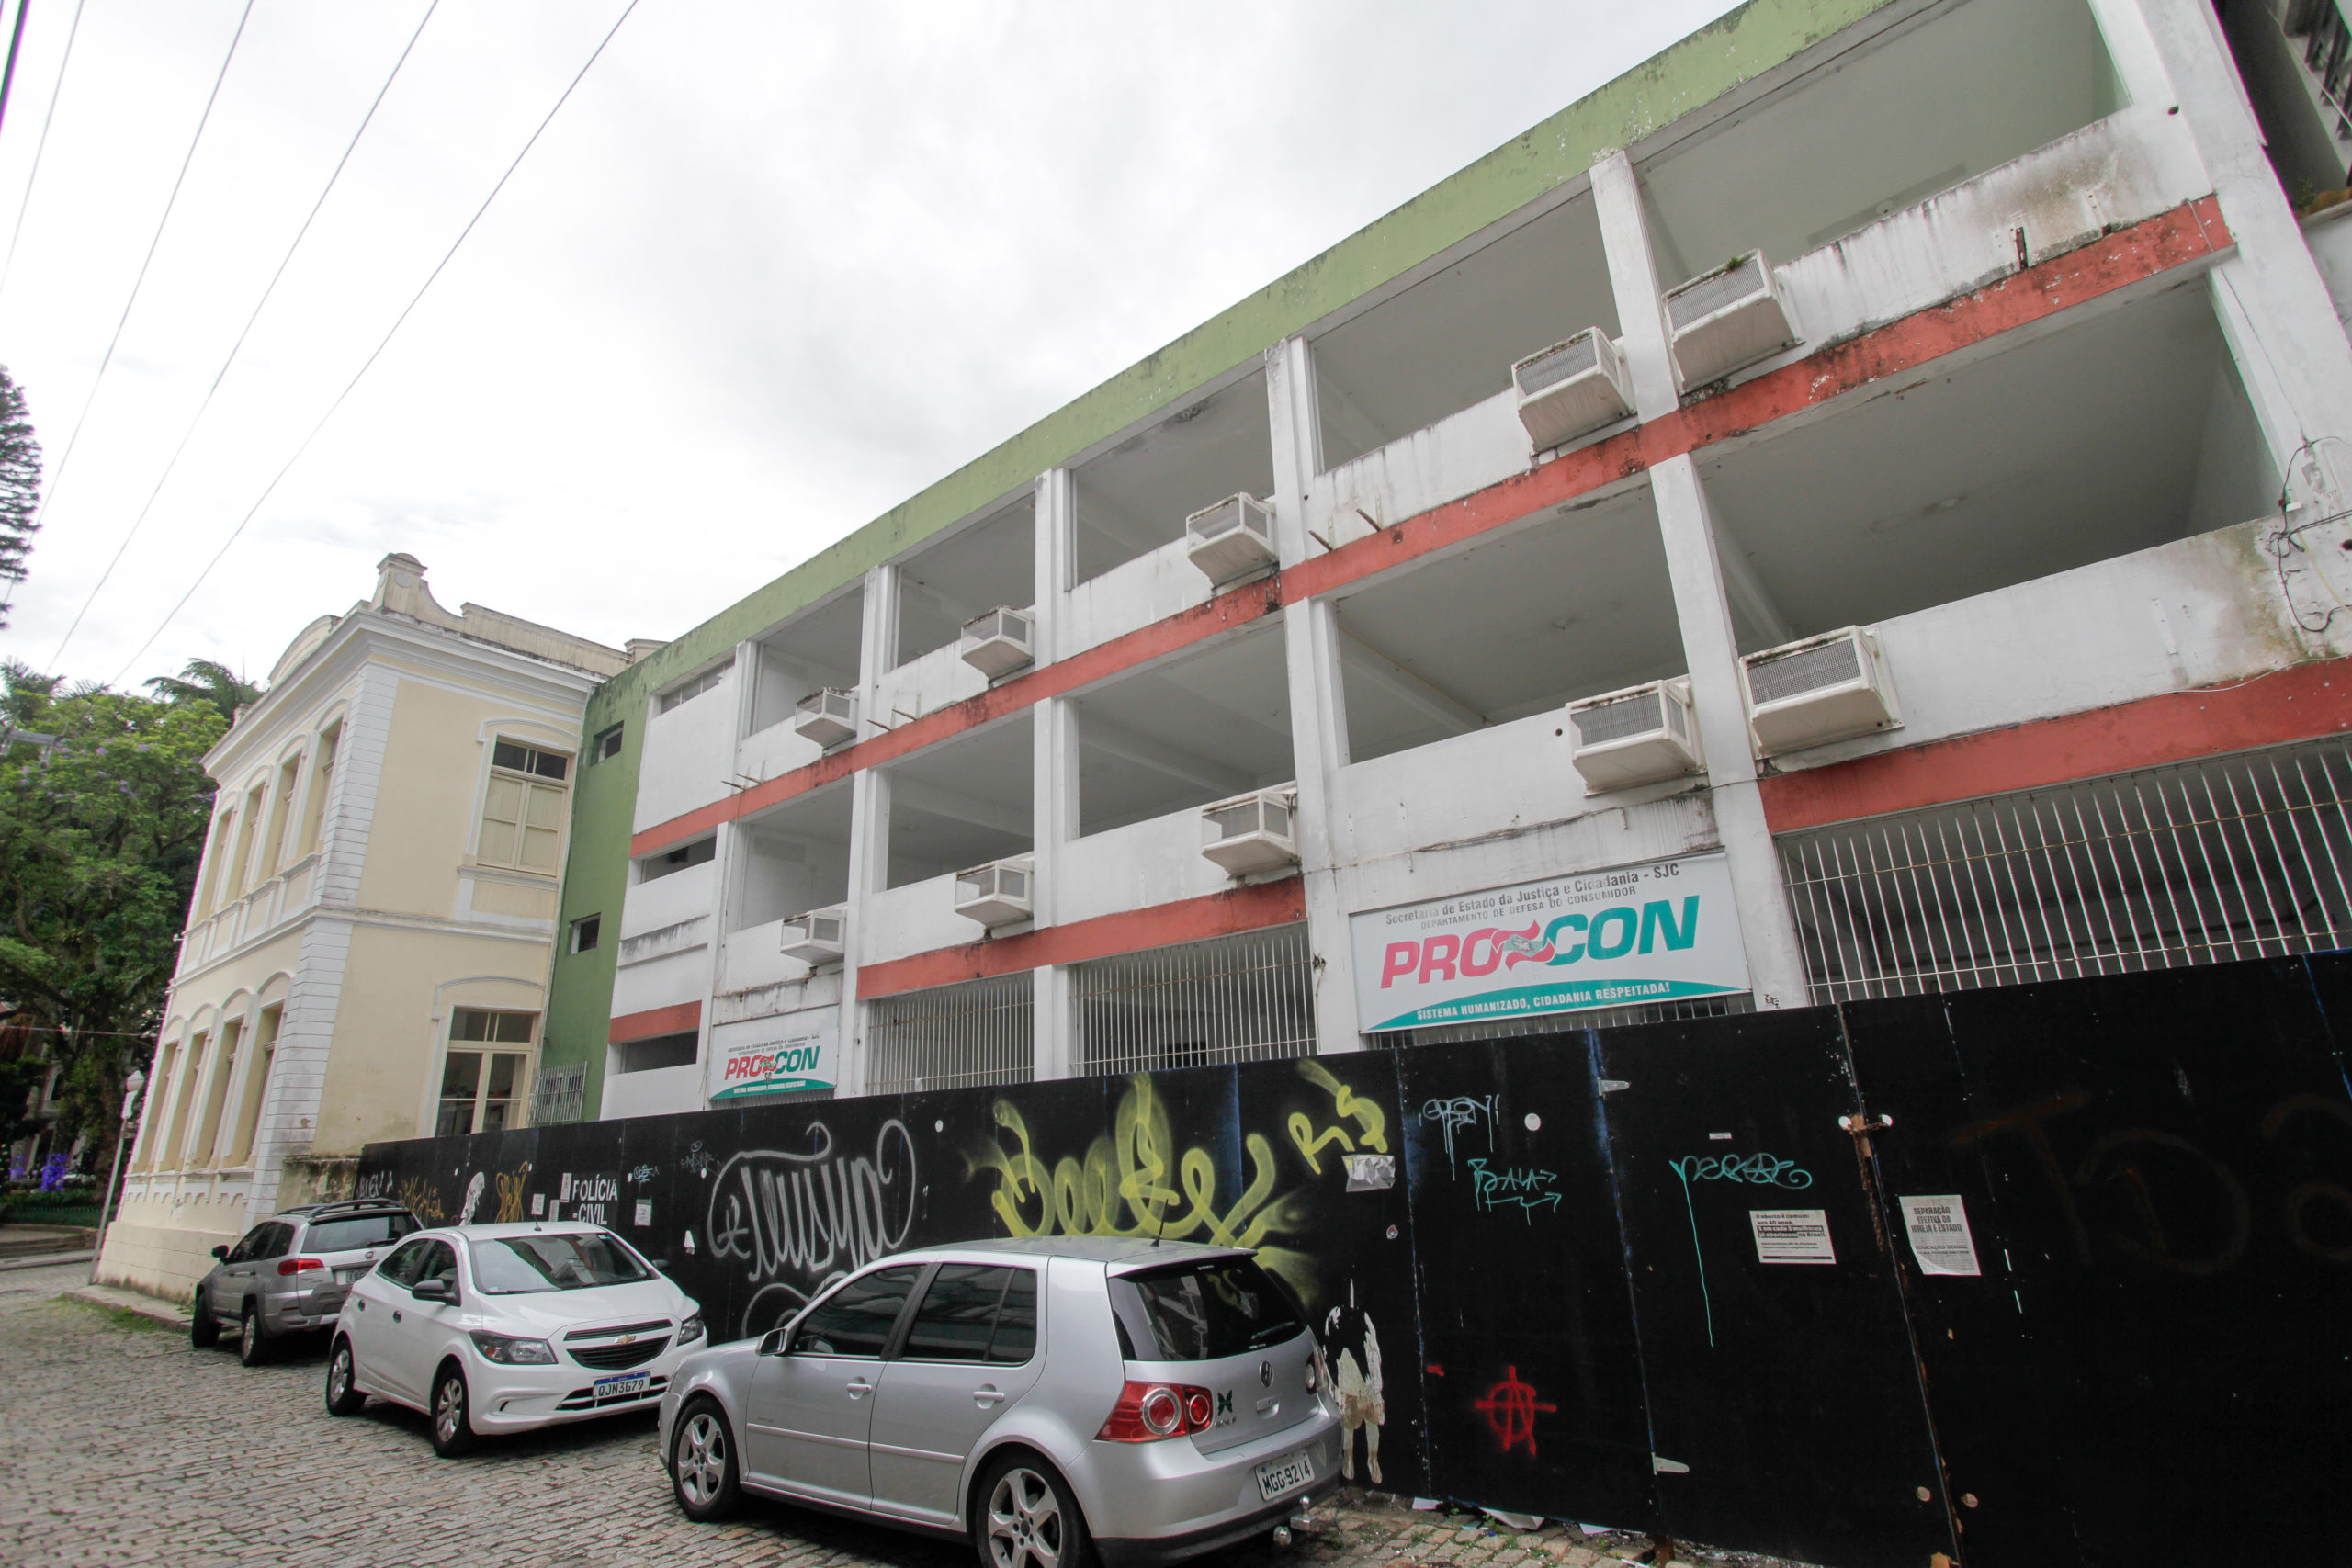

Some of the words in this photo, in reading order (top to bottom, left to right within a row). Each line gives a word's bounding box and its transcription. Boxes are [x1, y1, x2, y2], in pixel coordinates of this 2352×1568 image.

[1385, 908, 1439, 925] Secretaria
[1442, 902, 1455, 916] de
[1459, 897, 1495, 912] Estado
[1499, 893, 1513, 906] da
[1517, 886, 1560, 903] Justiça
[1564, 885, 1571, 894] e
[1574, 871, 1639, 893] Cidadania
[1654, 863, 1679, 879] SJC
[1421, 909, 1488, 930] DEPARTAMENTO
[1493, 908, 1505, 918] DE
[1510, 901, 1545, 914] DEFESA
[1567, 886, 1636, 905] CONSUMIDOR
[1417, 1007, 1458, 1021] SISTEMA
[1461, 998, 1531, 1015] HUMANIZADO,
[1533, 990, 1592, 1007] CIDADANIA
[1595, 982, 1670, 1000] RESPEITADA!
[1913, 1205, 1951, 1215] SEPARAÇÃO
[1917, 1215, 1941, 1224] EFETIVA
[1911, 1224, 1932, 1233] IGREJA
[1938, 1224, 1962, 1232] ESTADO
[598, 1379, 645, 1396] QJN3G79
